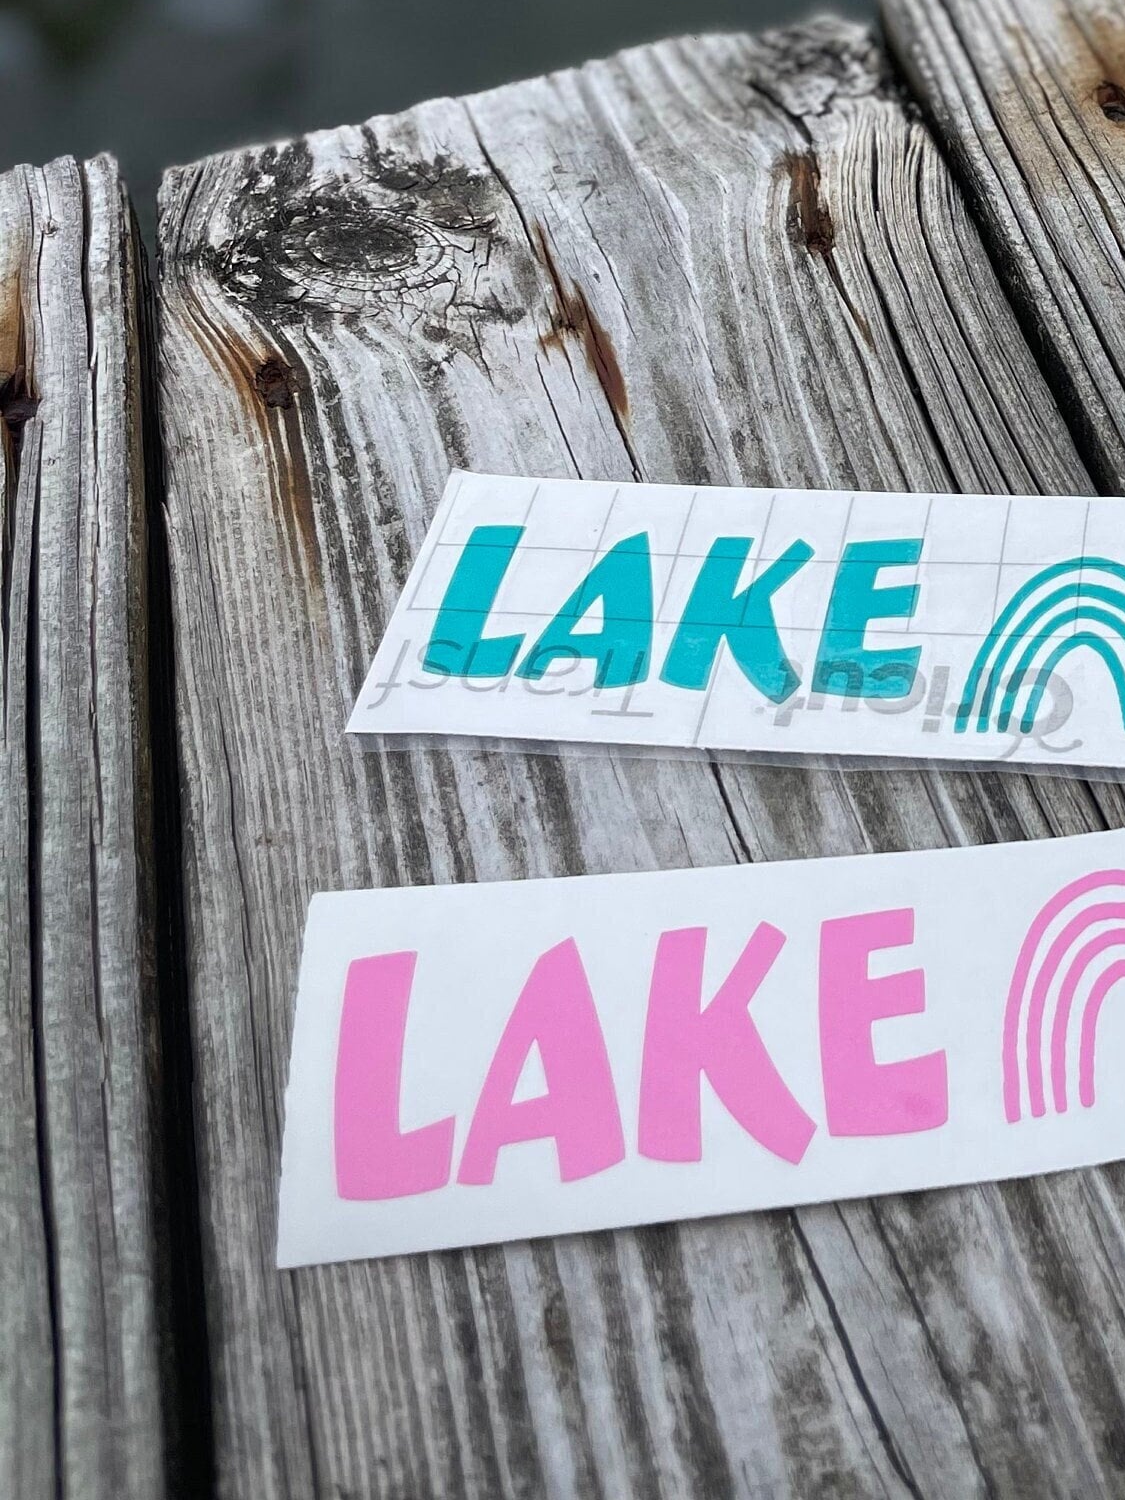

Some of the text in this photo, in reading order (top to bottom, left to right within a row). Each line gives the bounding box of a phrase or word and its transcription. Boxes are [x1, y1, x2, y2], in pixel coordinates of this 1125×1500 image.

[366, 637, 1083, 759] Cricut Transf
[421, 524, 924, 702] LAKE
[333, 907, 949, 1202] LAKE
